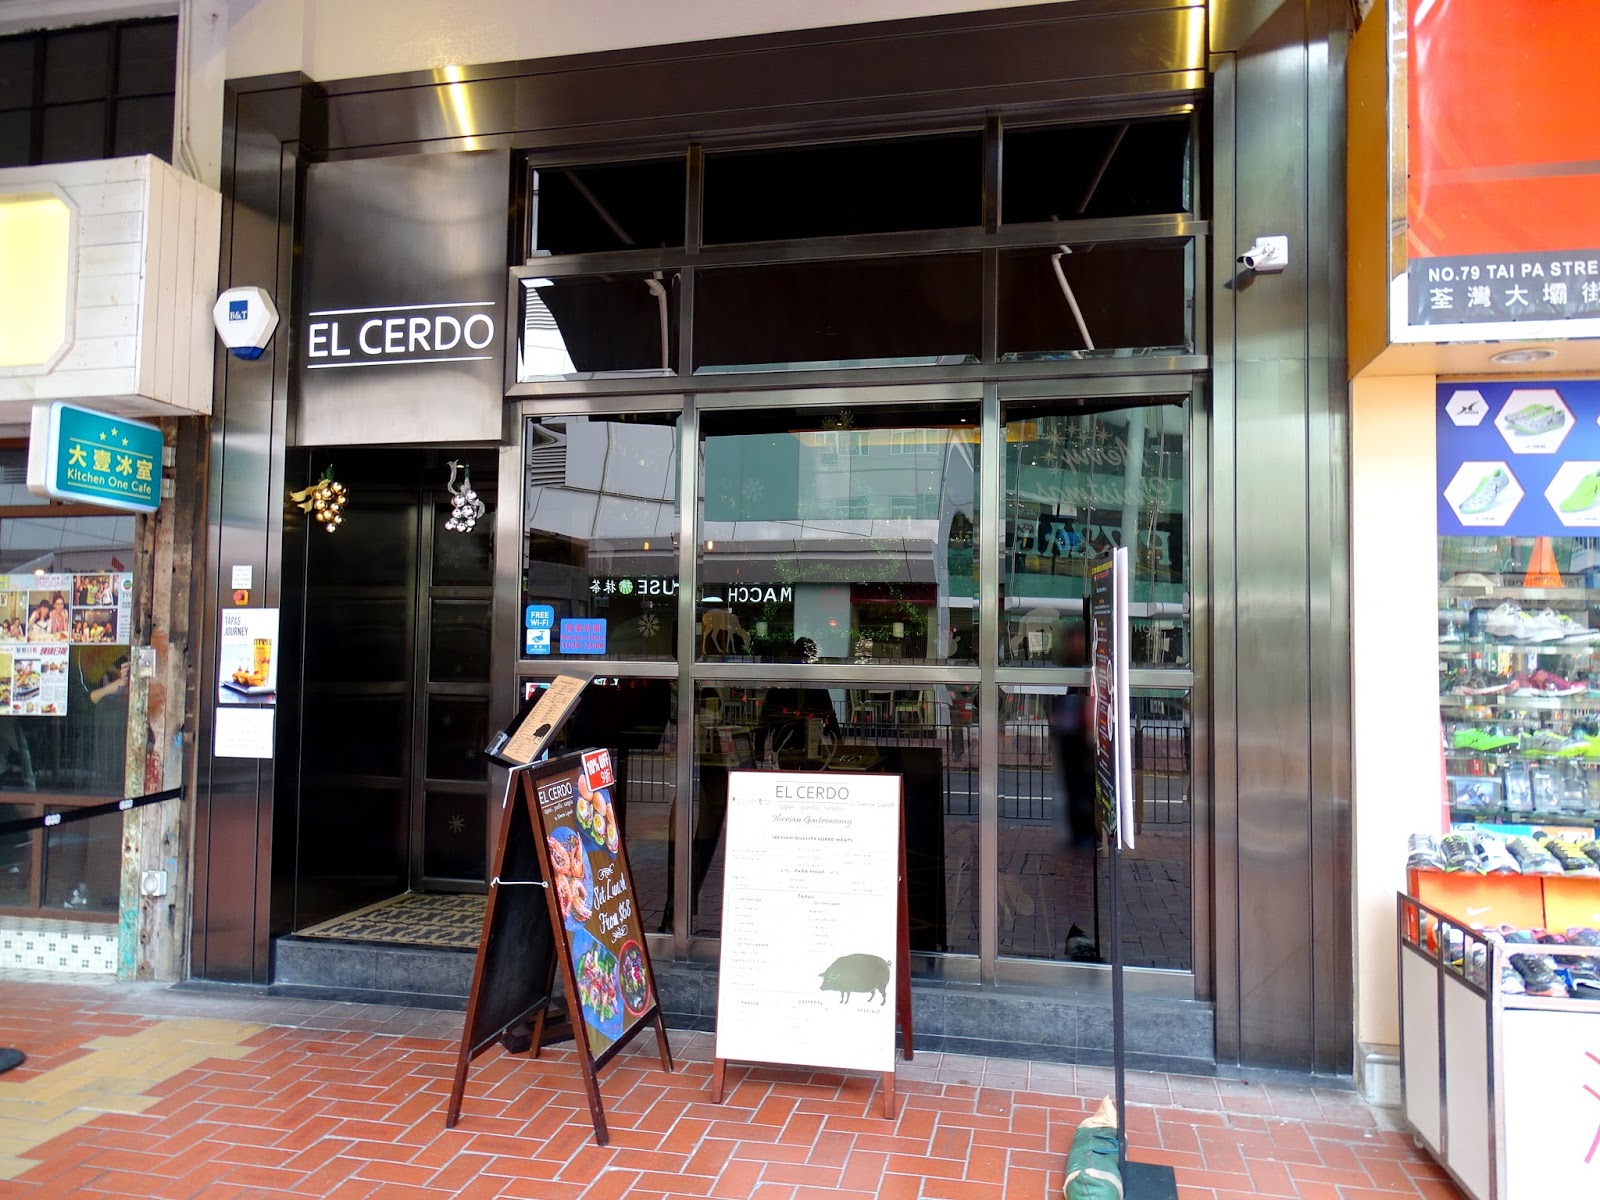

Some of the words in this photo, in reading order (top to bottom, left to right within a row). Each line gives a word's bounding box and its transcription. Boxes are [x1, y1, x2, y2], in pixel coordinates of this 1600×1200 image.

[1428, 265, 1480, 282] NO.79
[1487, 263, 1514, 280] TAI
[1521, 262, 1545, 278] PA
[230, 311, 248, 320] B&T
[308, 322, 351, 358] EL
[359, 313, 495, 355] CERDO
[67, 467, 105, 485] Kitchen
[108, 475, 128, 490] One
[131, 480, 152, 494] Cafe
[225, 616, 241, 626] TAPAS
[530, 611, 550, 619] FREE
[224, 626, 249, 637] JOURNEY
[586, 757, 600, 776] 10%
[538, 790, 550, 804] EL
[548, 782, 573, 801] CERDO
[775, 785, 793, 799] EL
[796, 786, 850, 800] CERDO
[803, 815, 853, 828] Gastronomy
[593, 885, 606, 911] Set
[607, 872, 627, 901] Lunch
[599, 912, 619, 934] From
